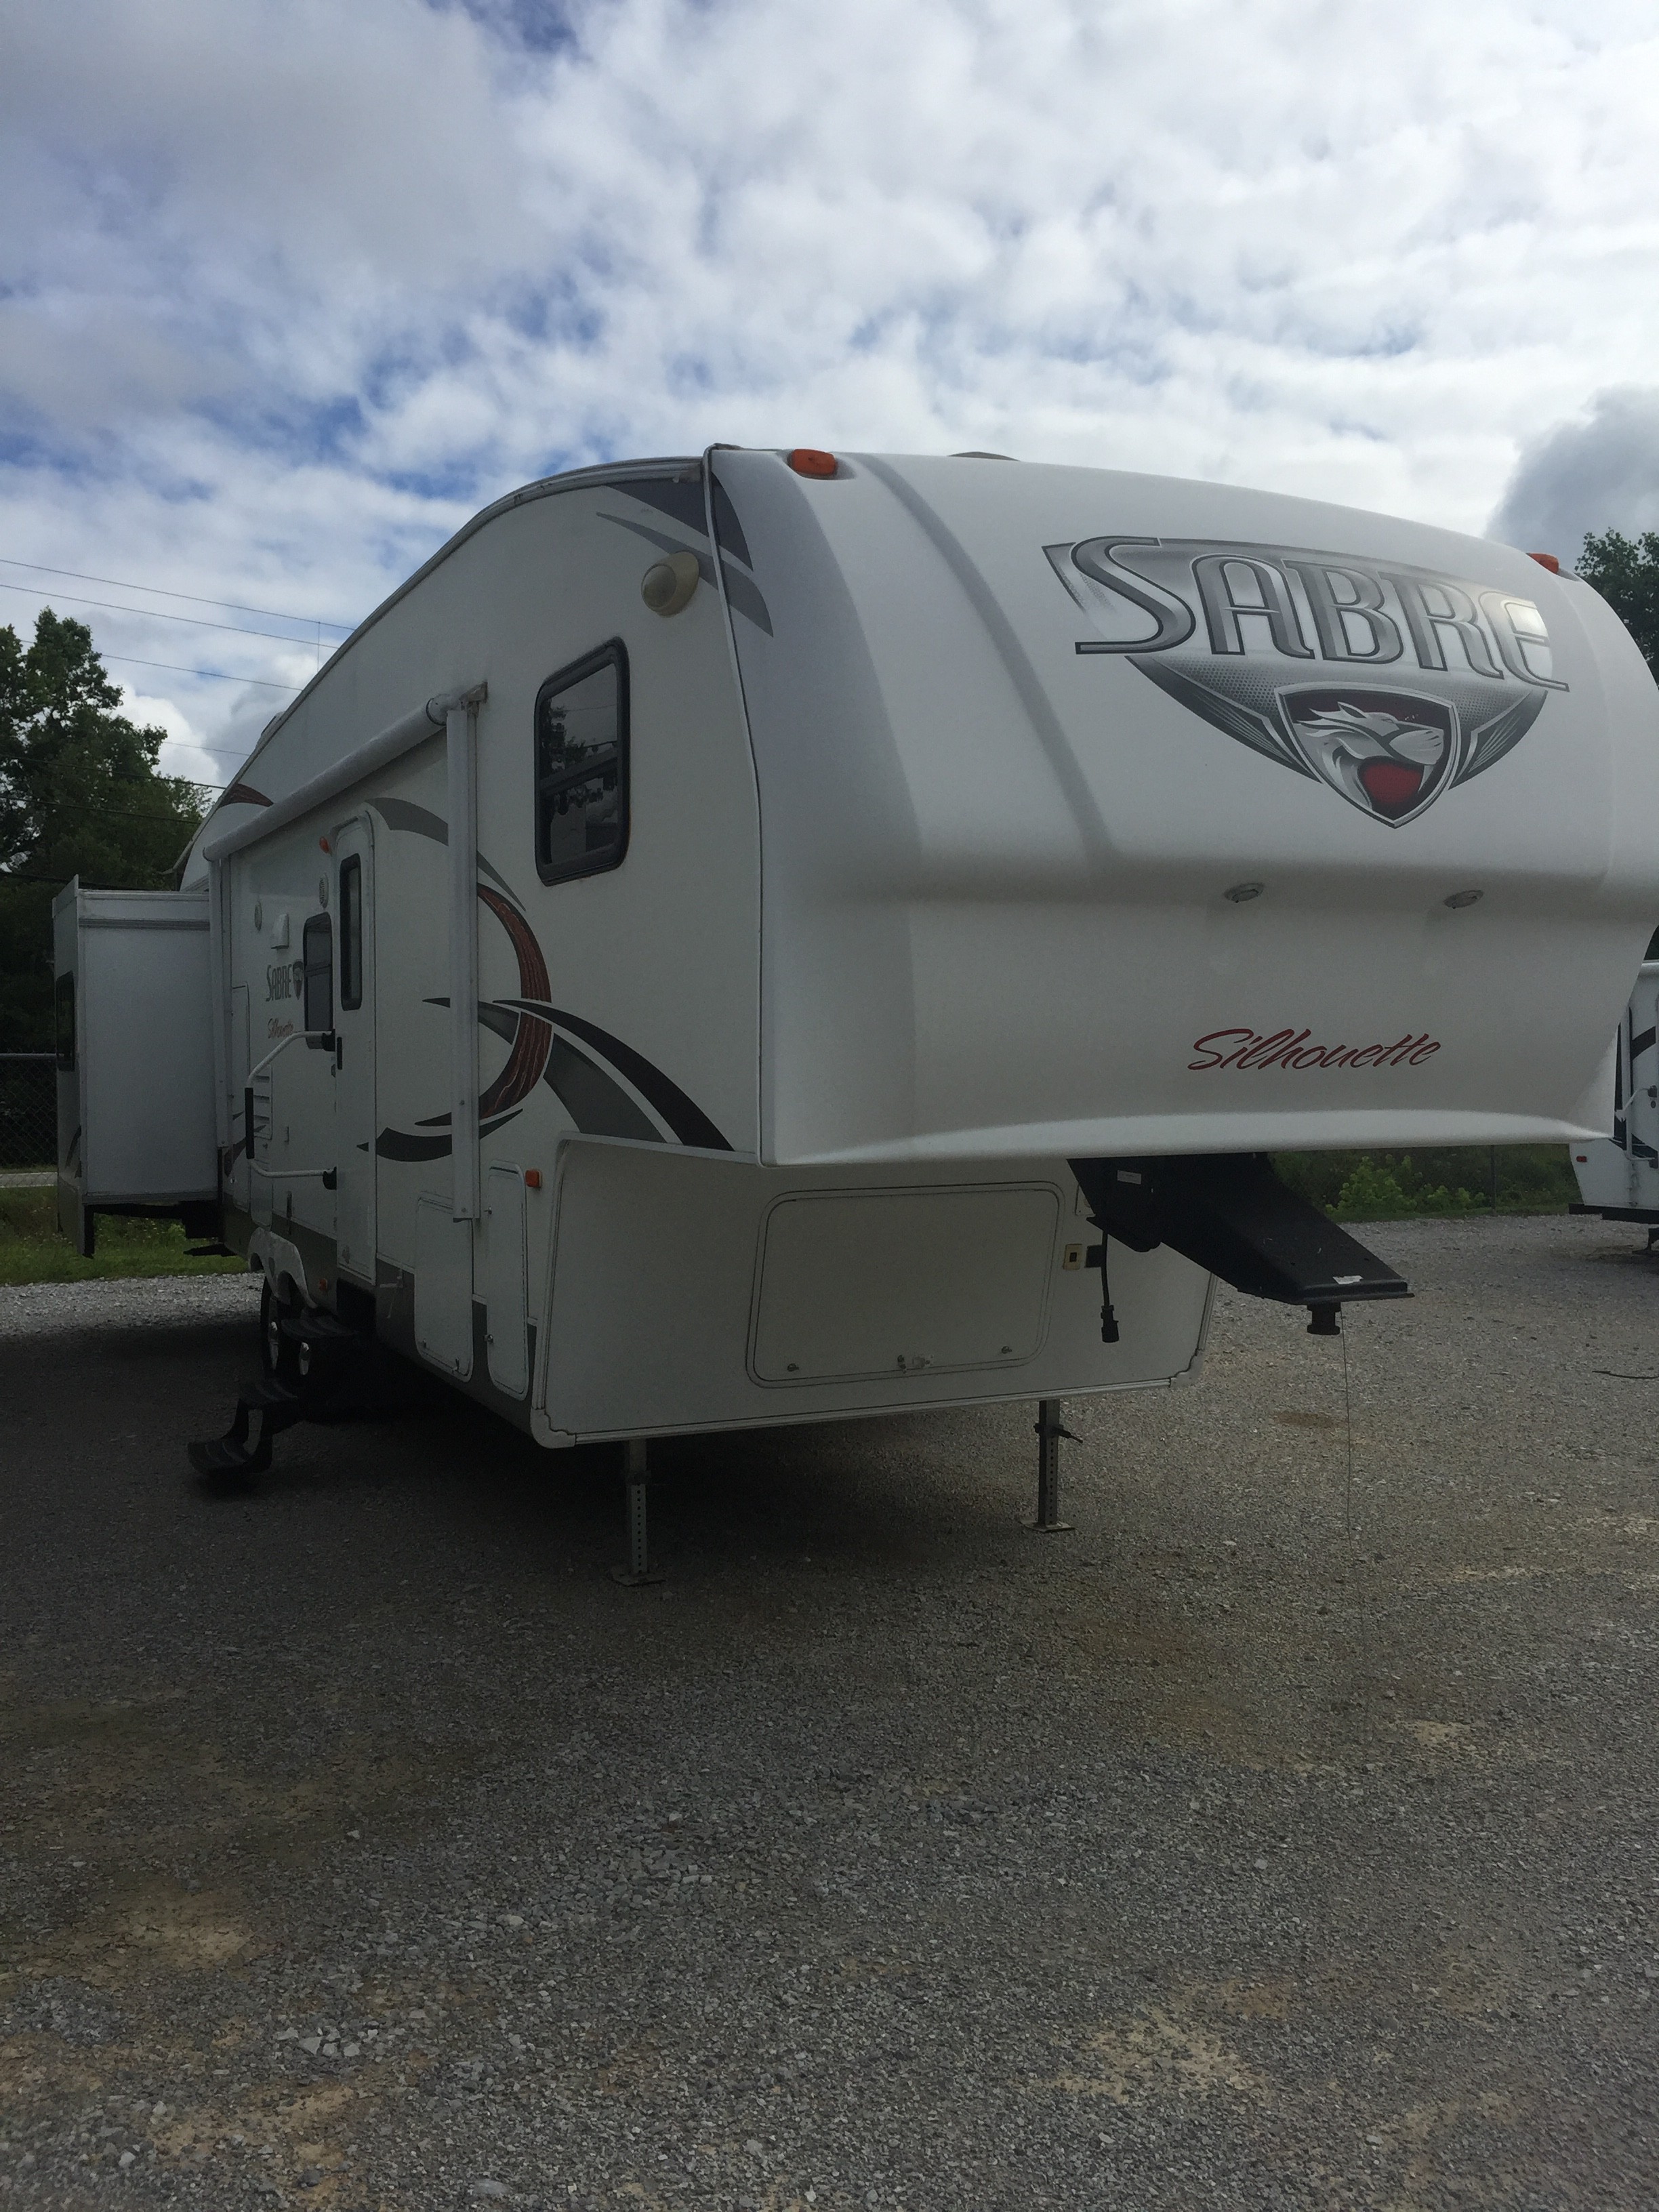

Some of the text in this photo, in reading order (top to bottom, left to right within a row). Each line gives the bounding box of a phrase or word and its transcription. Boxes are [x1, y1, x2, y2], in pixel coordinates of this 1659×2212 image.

[1071, 535, 1569, 692] SABRE
[266, 964, 292, 1002] SABRE
[1187, 1028, 1441, 1070] Silhouette
